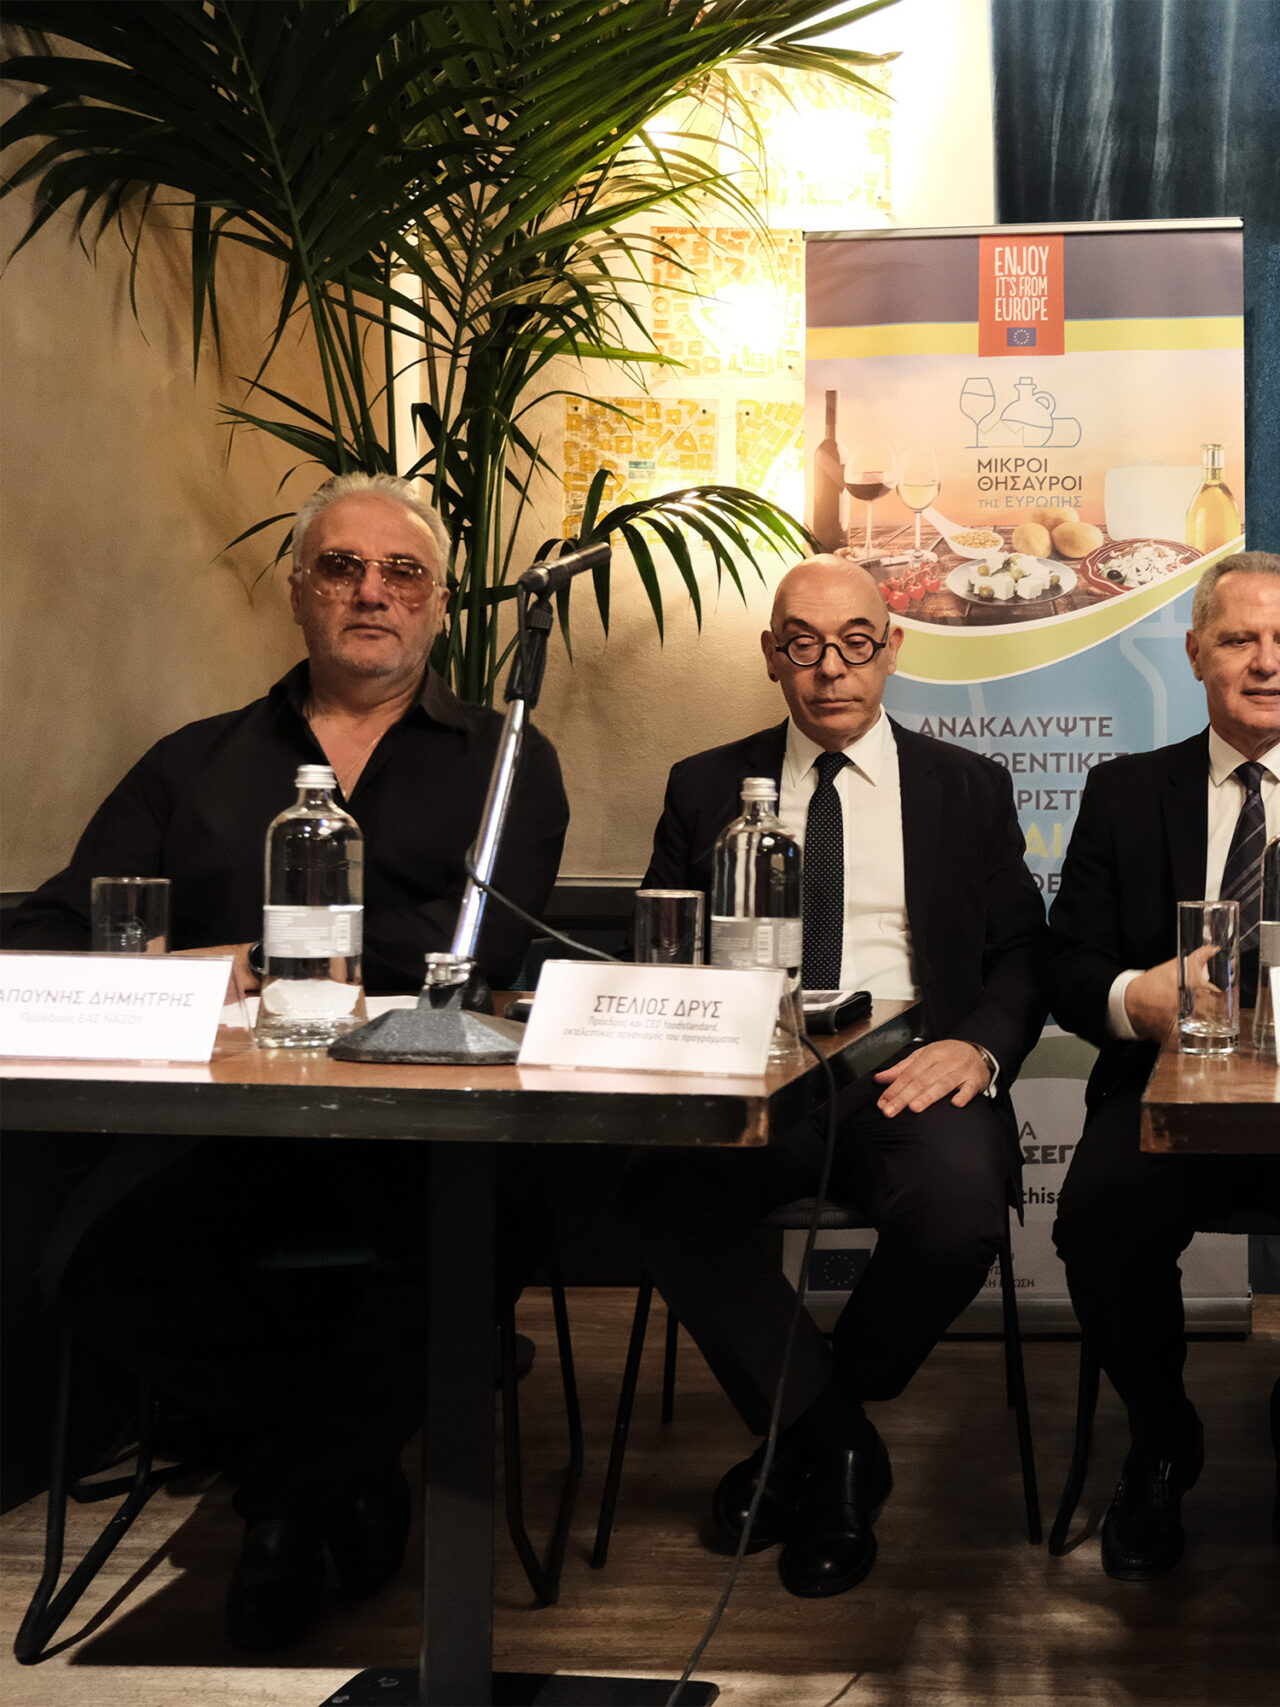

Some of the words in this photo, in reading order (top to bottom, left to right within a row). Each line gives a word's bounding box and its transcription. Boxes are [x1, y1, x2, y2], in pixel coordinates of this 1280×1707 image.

[995, 245, 1049, 276] ENJOY
[996, 276, 1017, 297] IT'S
[1019, 275, 1048, 297] FROM
[995, 296, 1049, 322] EUROPE
[977, 457, 1048, 473] ΜΙΚΡΟΙ
[977, 475, 1082, 492] ΘΗΣΑΥΡΟΙ
[1005, 495, 1083, 508] ΕΥΡΩΠΗΣ
[919, 716, 1113, 738] ΑΝΑΚΑΛΥΨΤΕ
[89, 991, 195, 1008] ΔΗΜΗΤΡΗΣ
[593, 995, 670, 1016] ΣΤΕΛΙΟΣ
[674, 999, 723, 1018] ΔΡΥΣ
